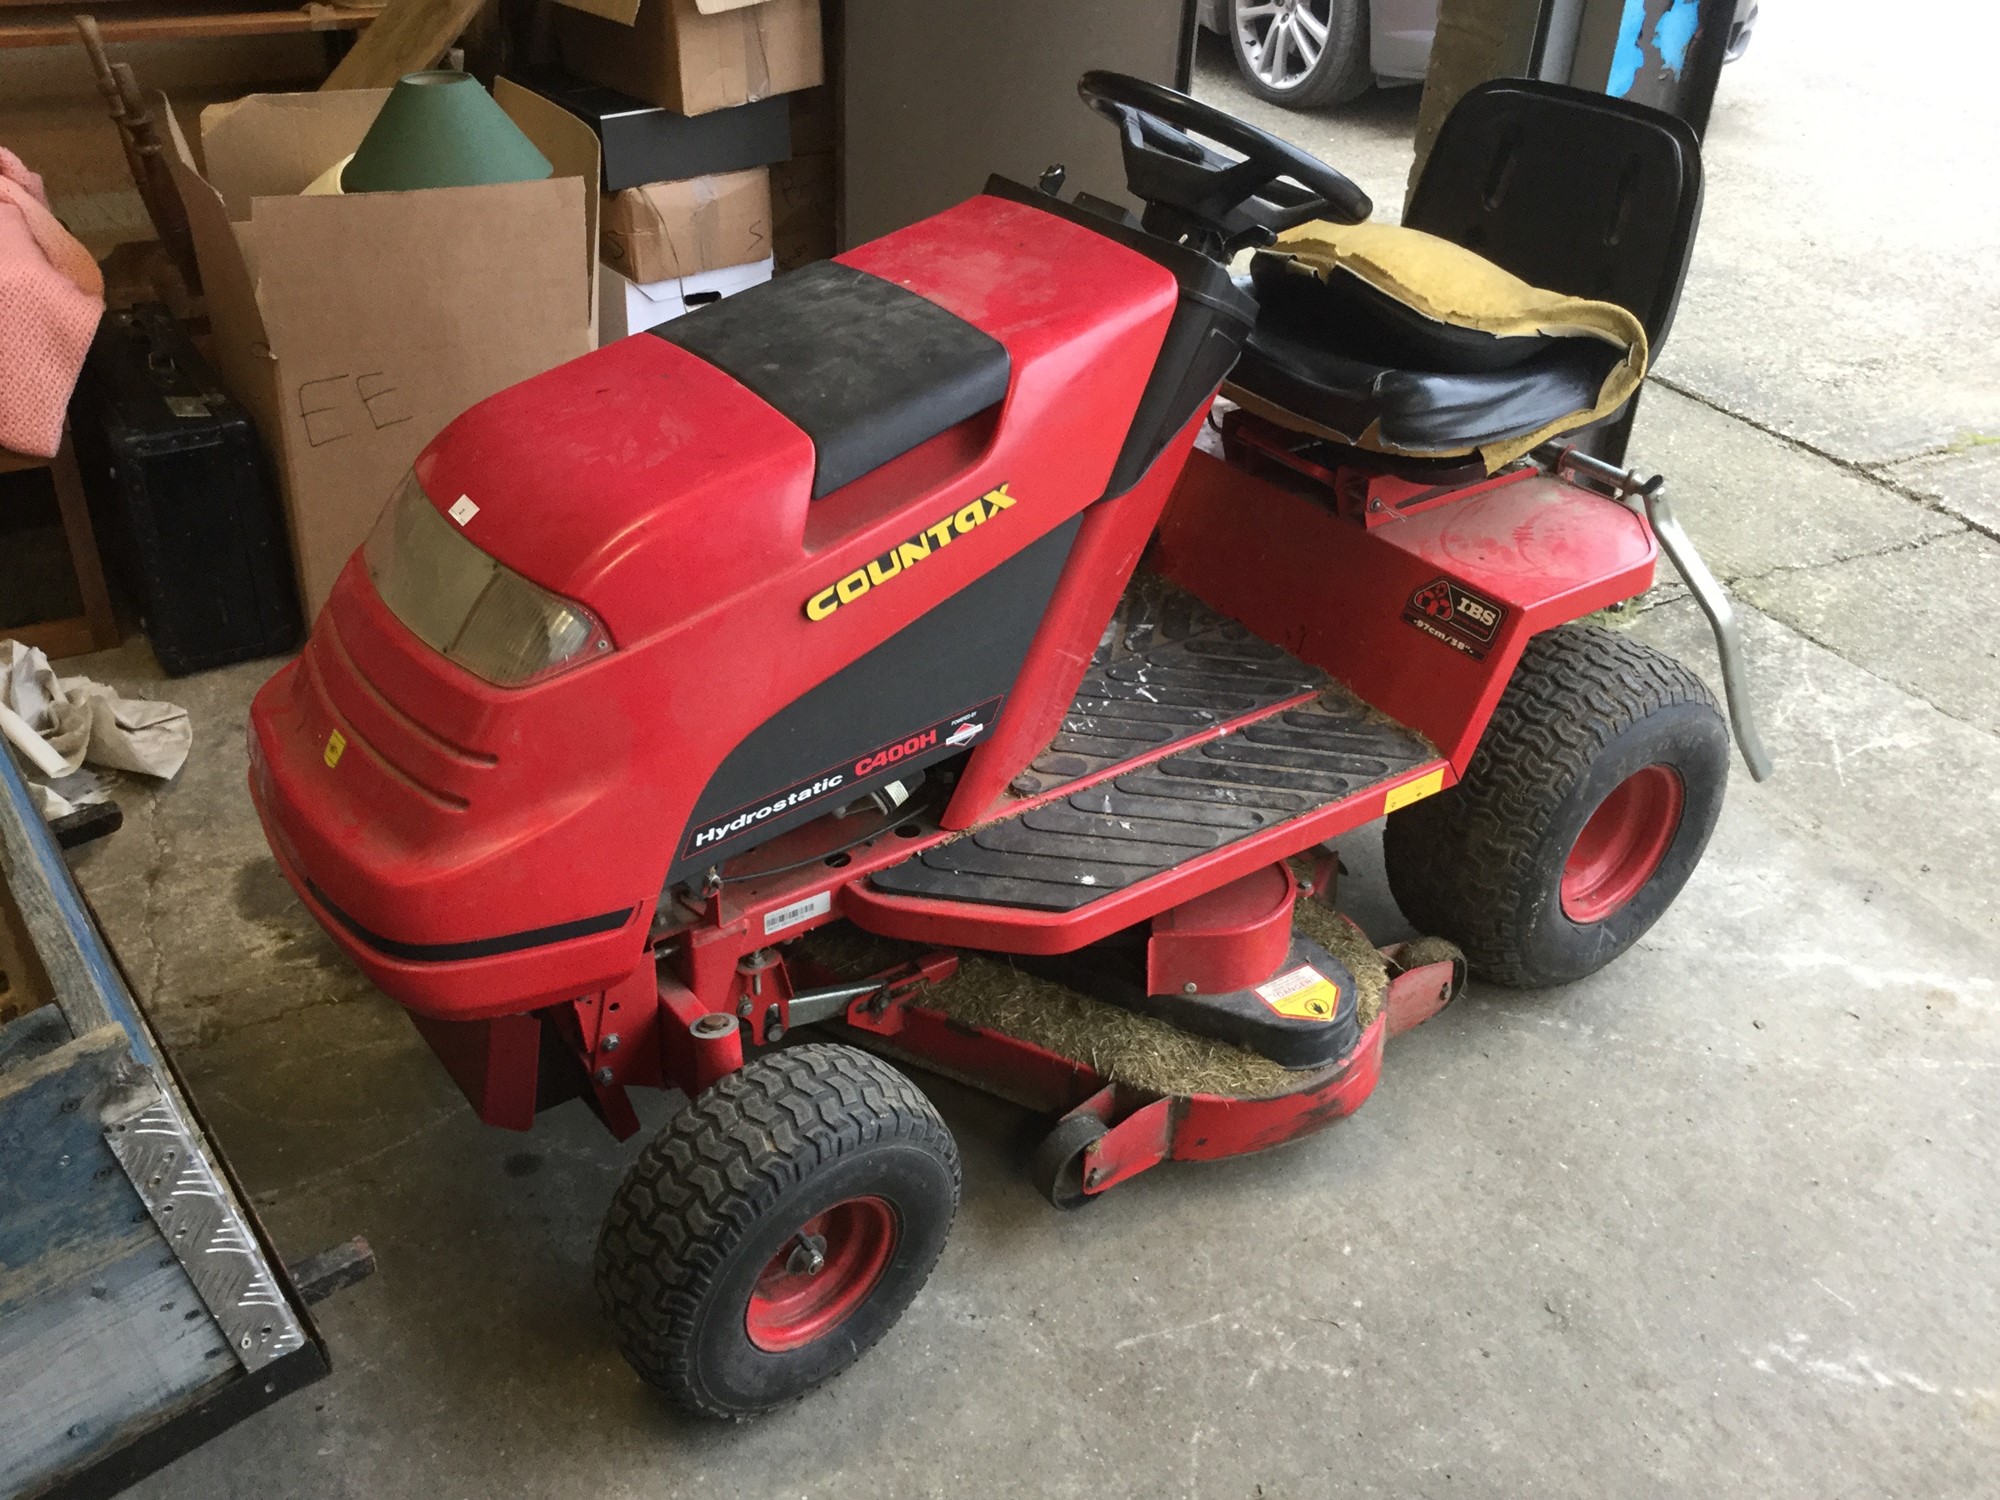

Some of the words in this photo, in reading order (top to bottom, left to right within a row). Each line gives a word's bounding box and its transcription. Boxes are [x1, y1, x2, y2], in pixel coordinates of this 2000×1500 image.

[298, 371, 414, 448] EE
[1456, 597, 1497, 626] IBS
[695, 774, 844, 847] Hydrostatic
[855, 729, 937, 777] C400H
